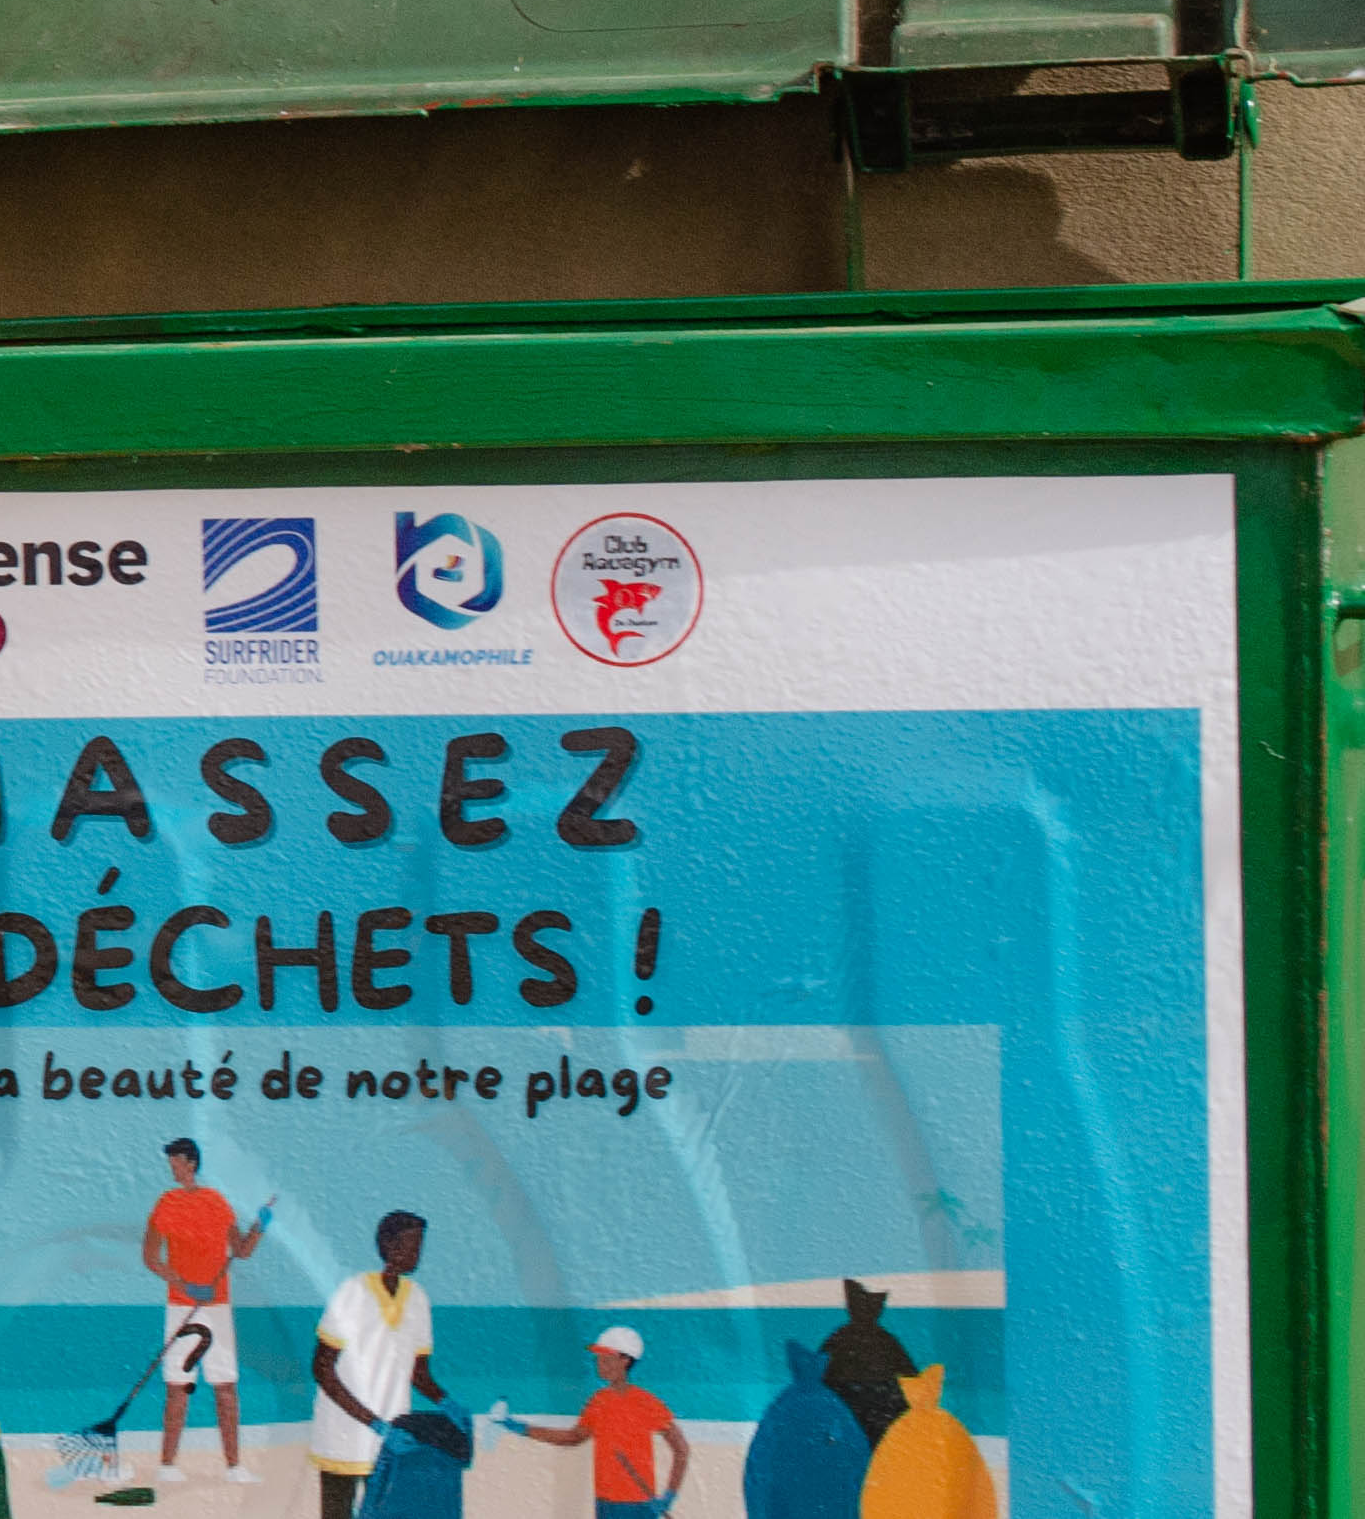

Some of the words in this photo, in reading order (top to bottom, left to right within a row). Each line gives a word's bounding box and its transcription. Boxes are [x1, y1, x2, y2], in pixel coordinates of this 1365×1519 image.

[604, 535, 648, 554] Club
[204, 639, 320, 665] SURFRIDER
[372, 648, 534, 668] OUAKAMOPHILE
[43, 1049, 237, 1102] beauté
[261, 1050, 325, 1102] de
[347, 1058, 504, 1103] notre
[526, 1055, 673, 1120] plage
